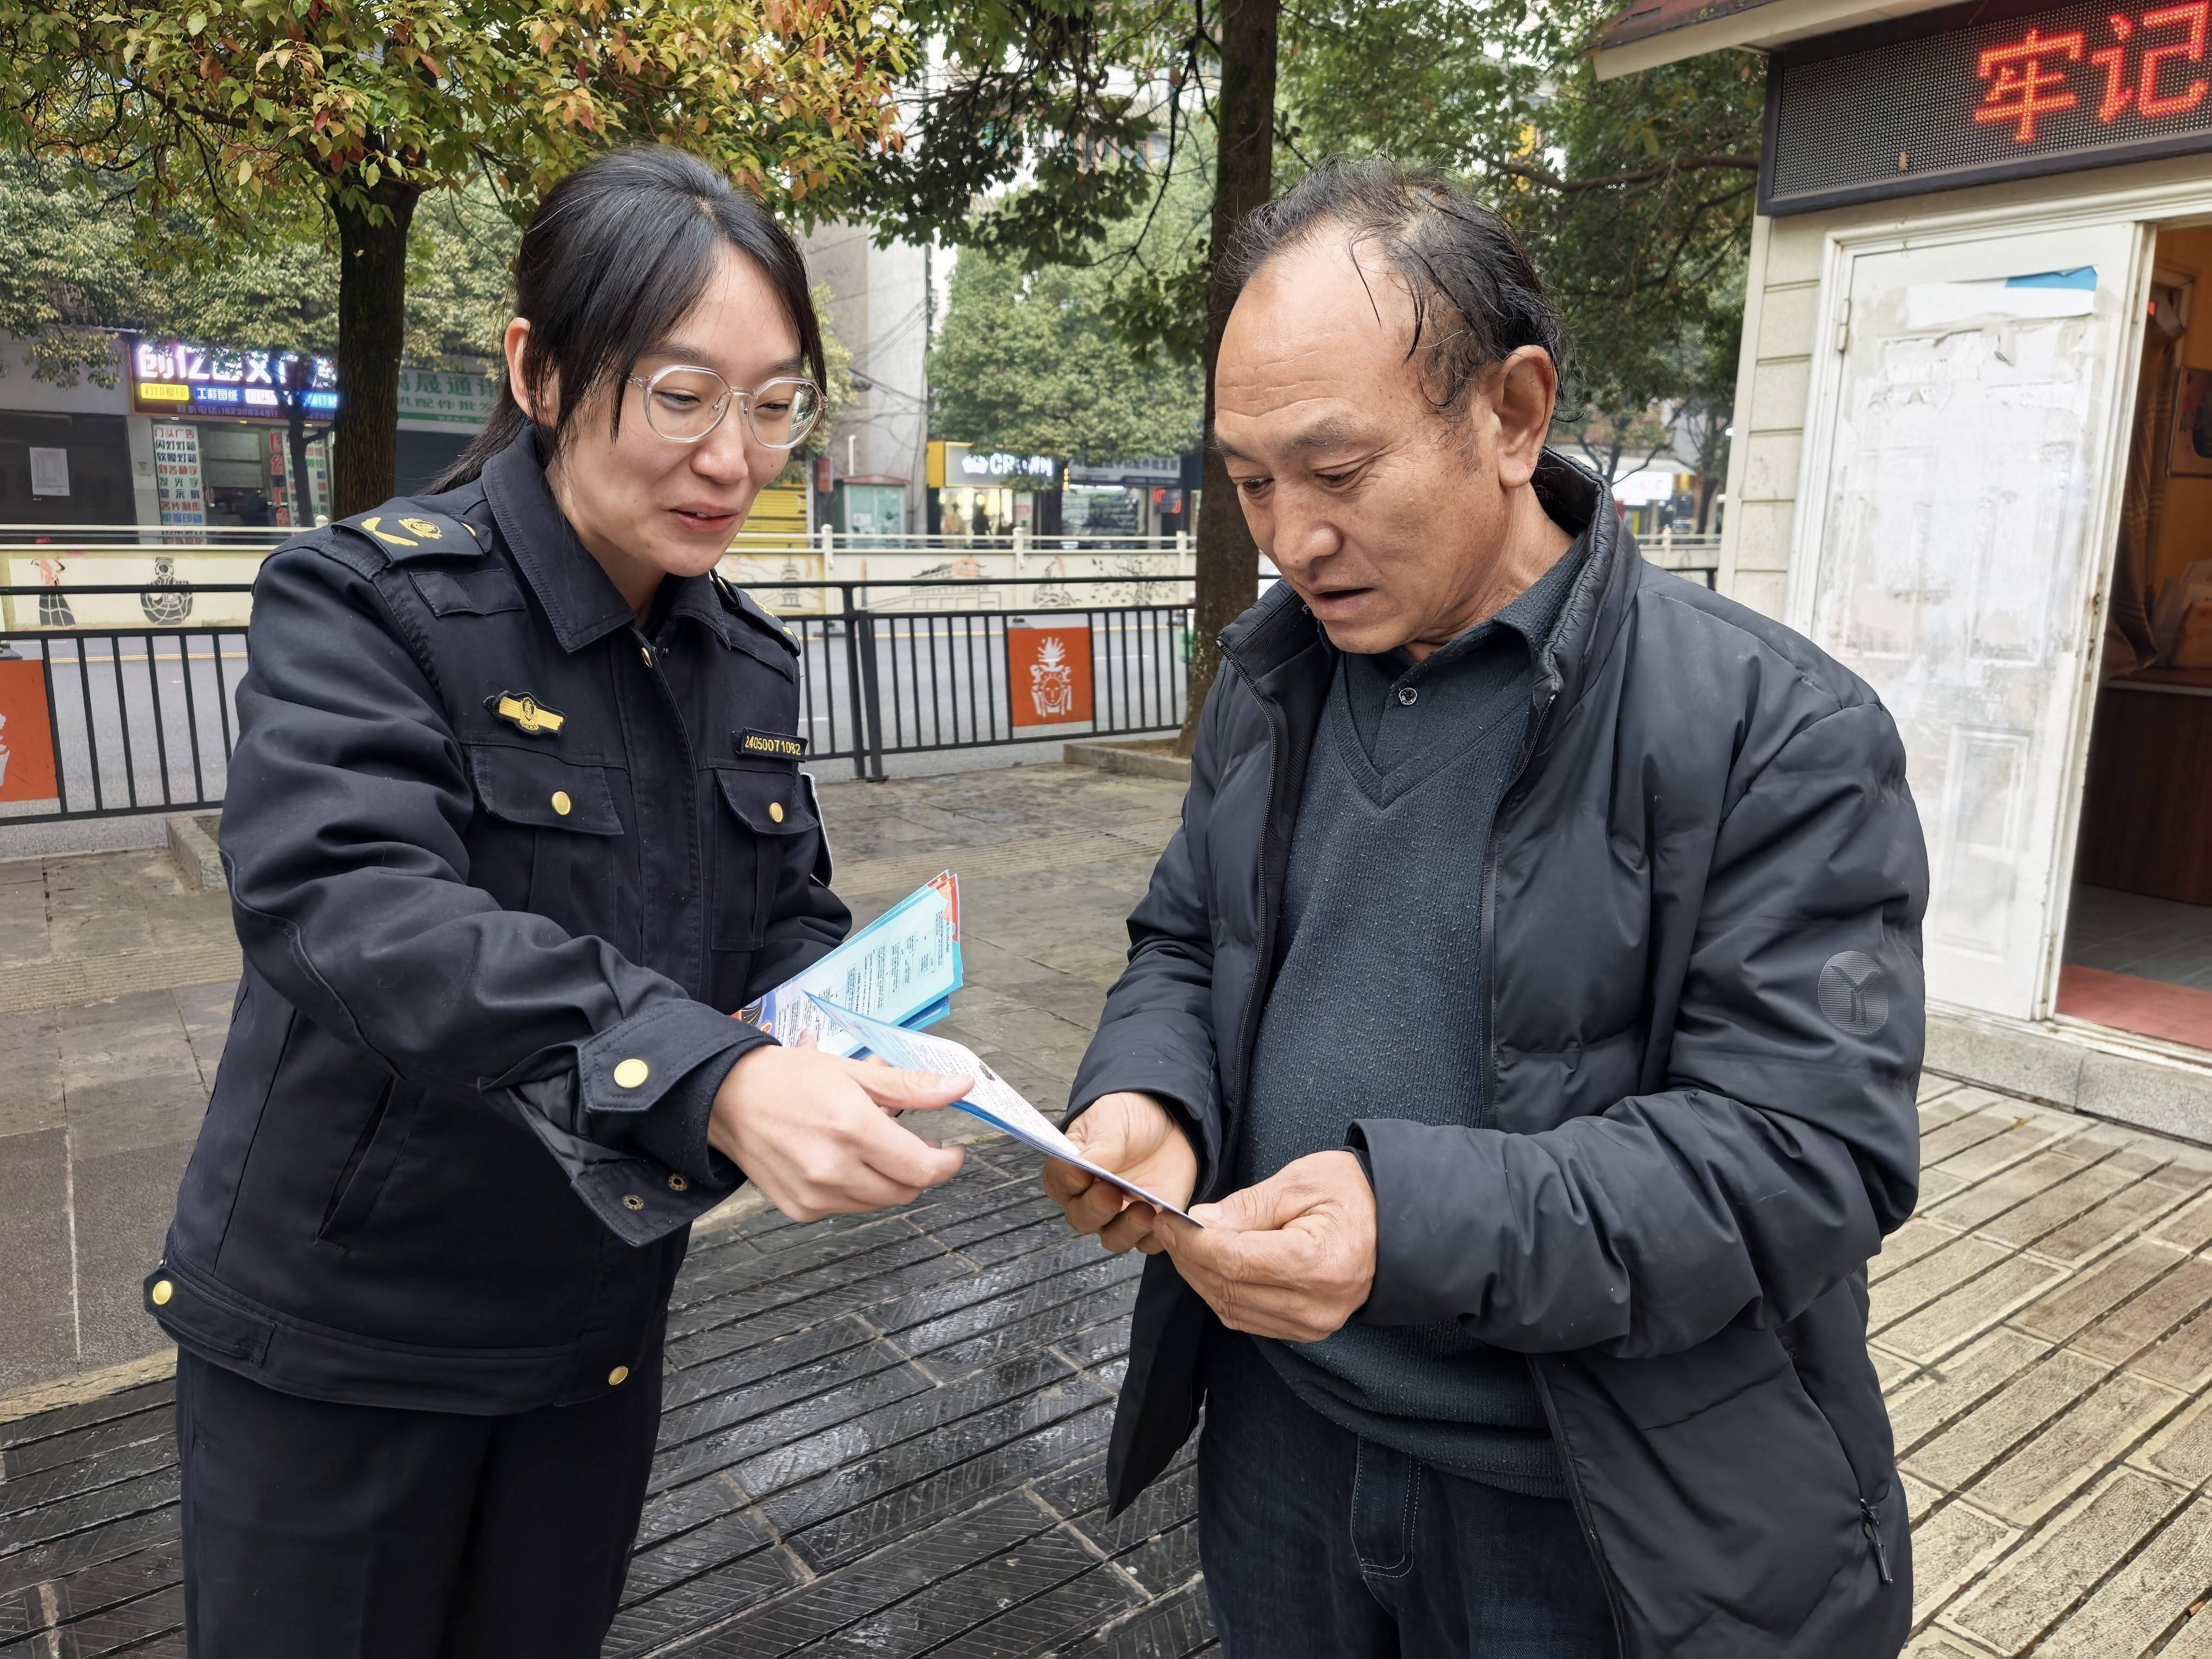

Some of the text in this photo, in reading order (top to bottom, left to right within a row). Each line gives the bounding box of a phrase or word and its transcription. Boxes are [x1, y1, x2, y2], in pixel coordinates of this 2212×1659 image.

[1974, 1, 2211, 143] 牢记
[196, 387, 239, 402] 工程图纸
[155, 428, 194, 438] 门头广告
[745, 736, 801, 755] 24050071082
